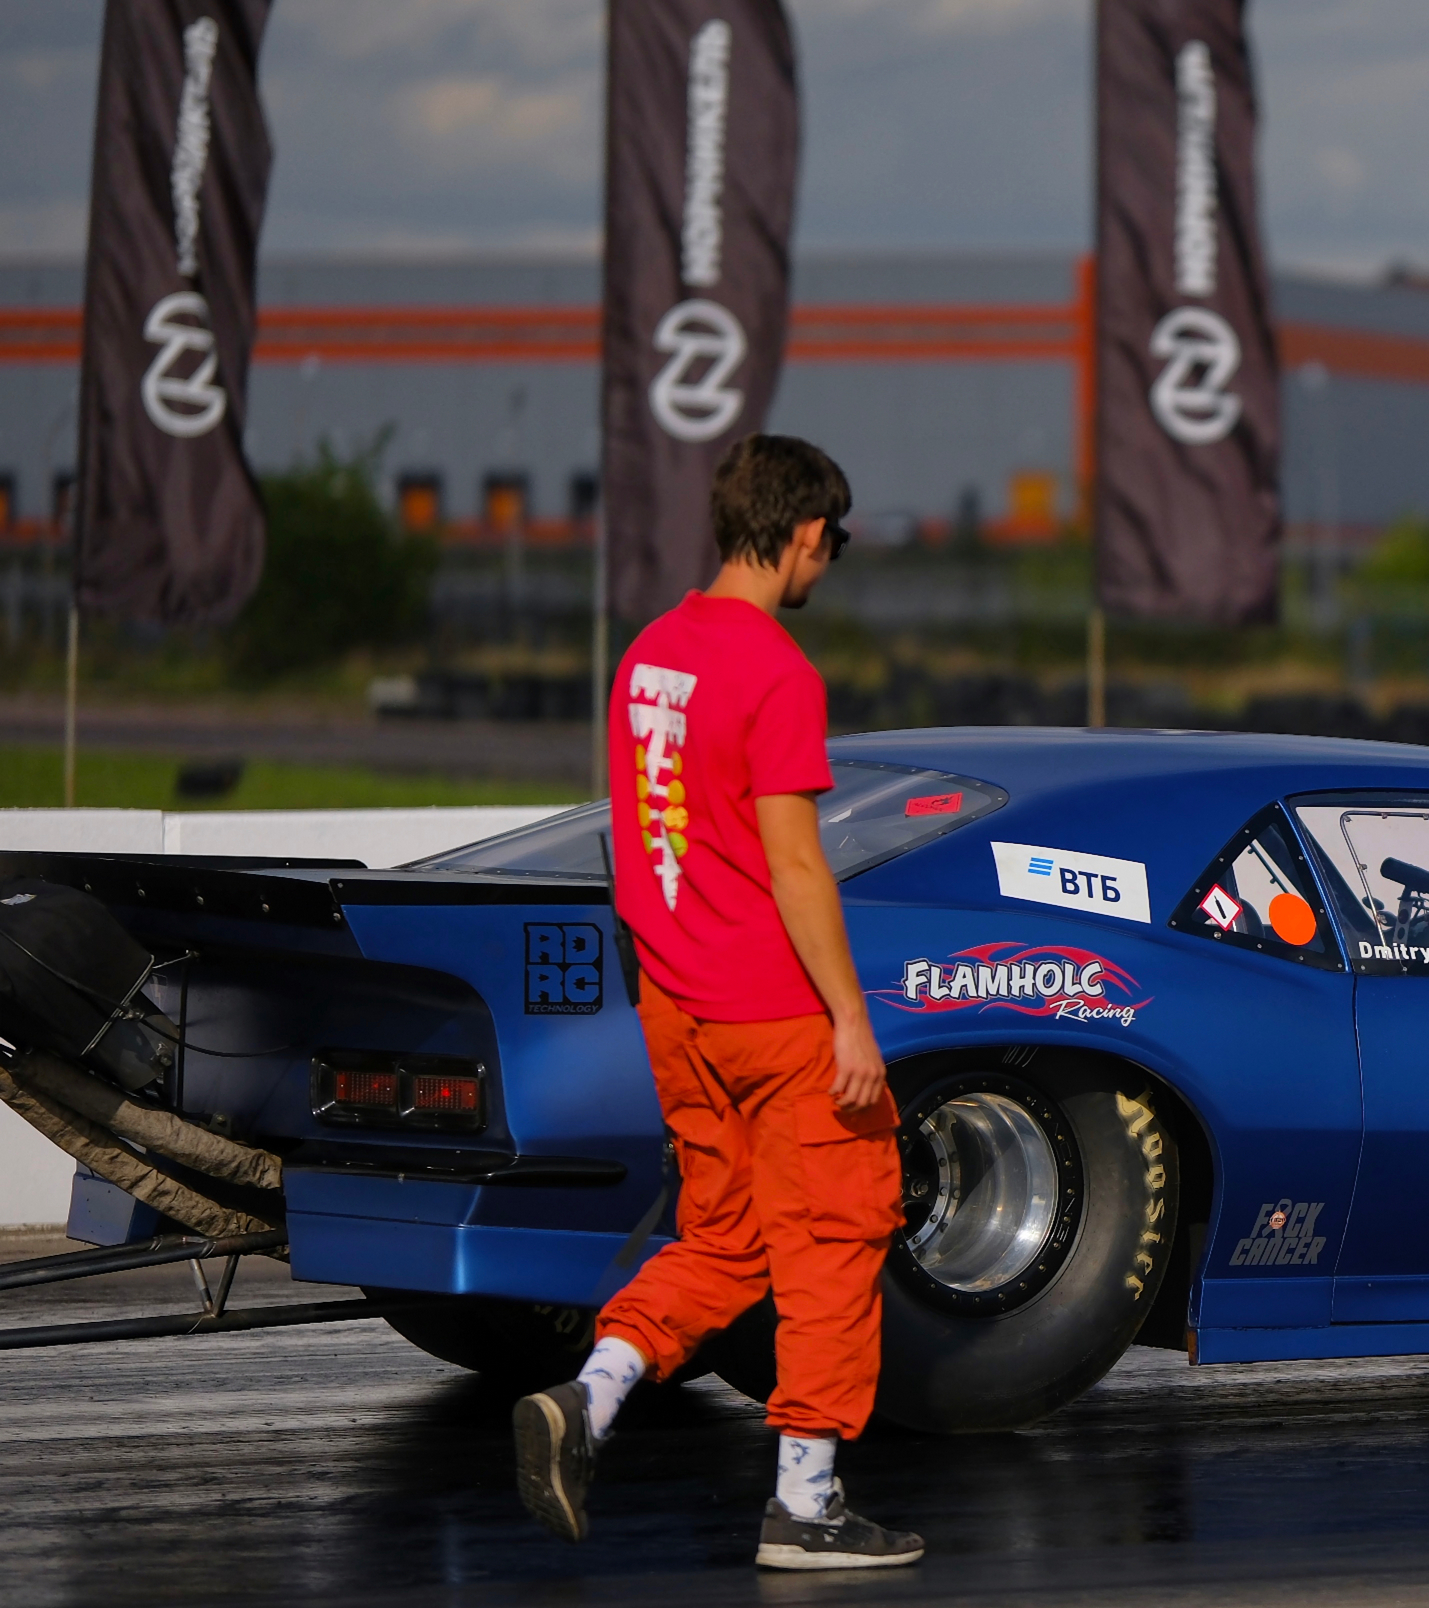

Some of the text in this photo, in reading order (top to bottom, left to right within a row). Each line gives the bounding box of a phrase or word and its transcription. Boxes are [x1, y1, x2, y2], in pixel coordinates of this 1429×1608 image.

[1059, 867, 1121, 903] ВТБ
[904, 959, 1105, 1000] FLAMHOLC
[528, 1004, 599, 1013] TECHNOLOGY
[1050, 999, 1136, 1027] Racing
